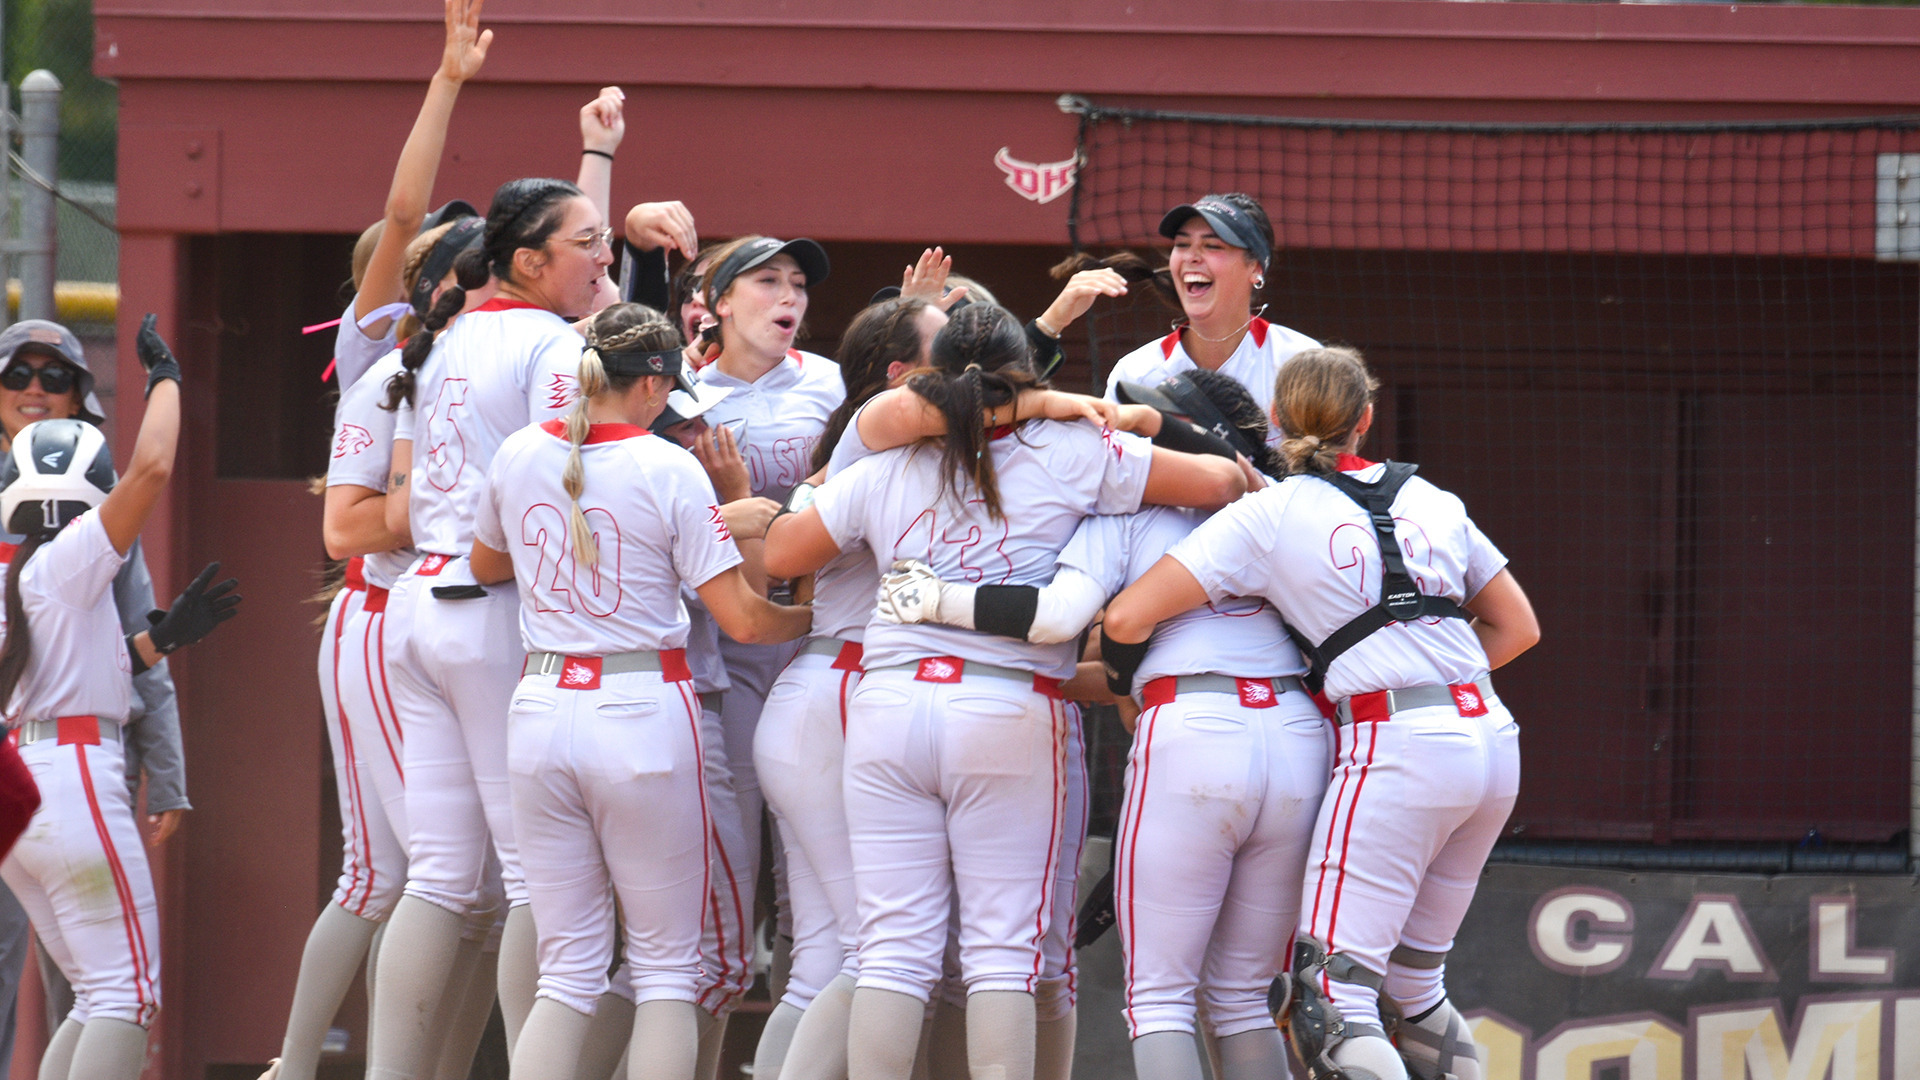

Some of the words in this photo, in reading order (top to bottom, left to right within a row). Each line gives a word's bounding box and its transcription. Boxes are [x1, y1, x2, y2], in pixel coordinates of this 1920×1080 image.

[1004, 161, 1077, 203] DH
[426, 377, 468, 493] 5
[40, 498, 61, 529] 1
[521, 502, 623, 618] 20
[1387, 591, 1417, 601] EASTON
[1528, 885, 1896, 983] CAL
